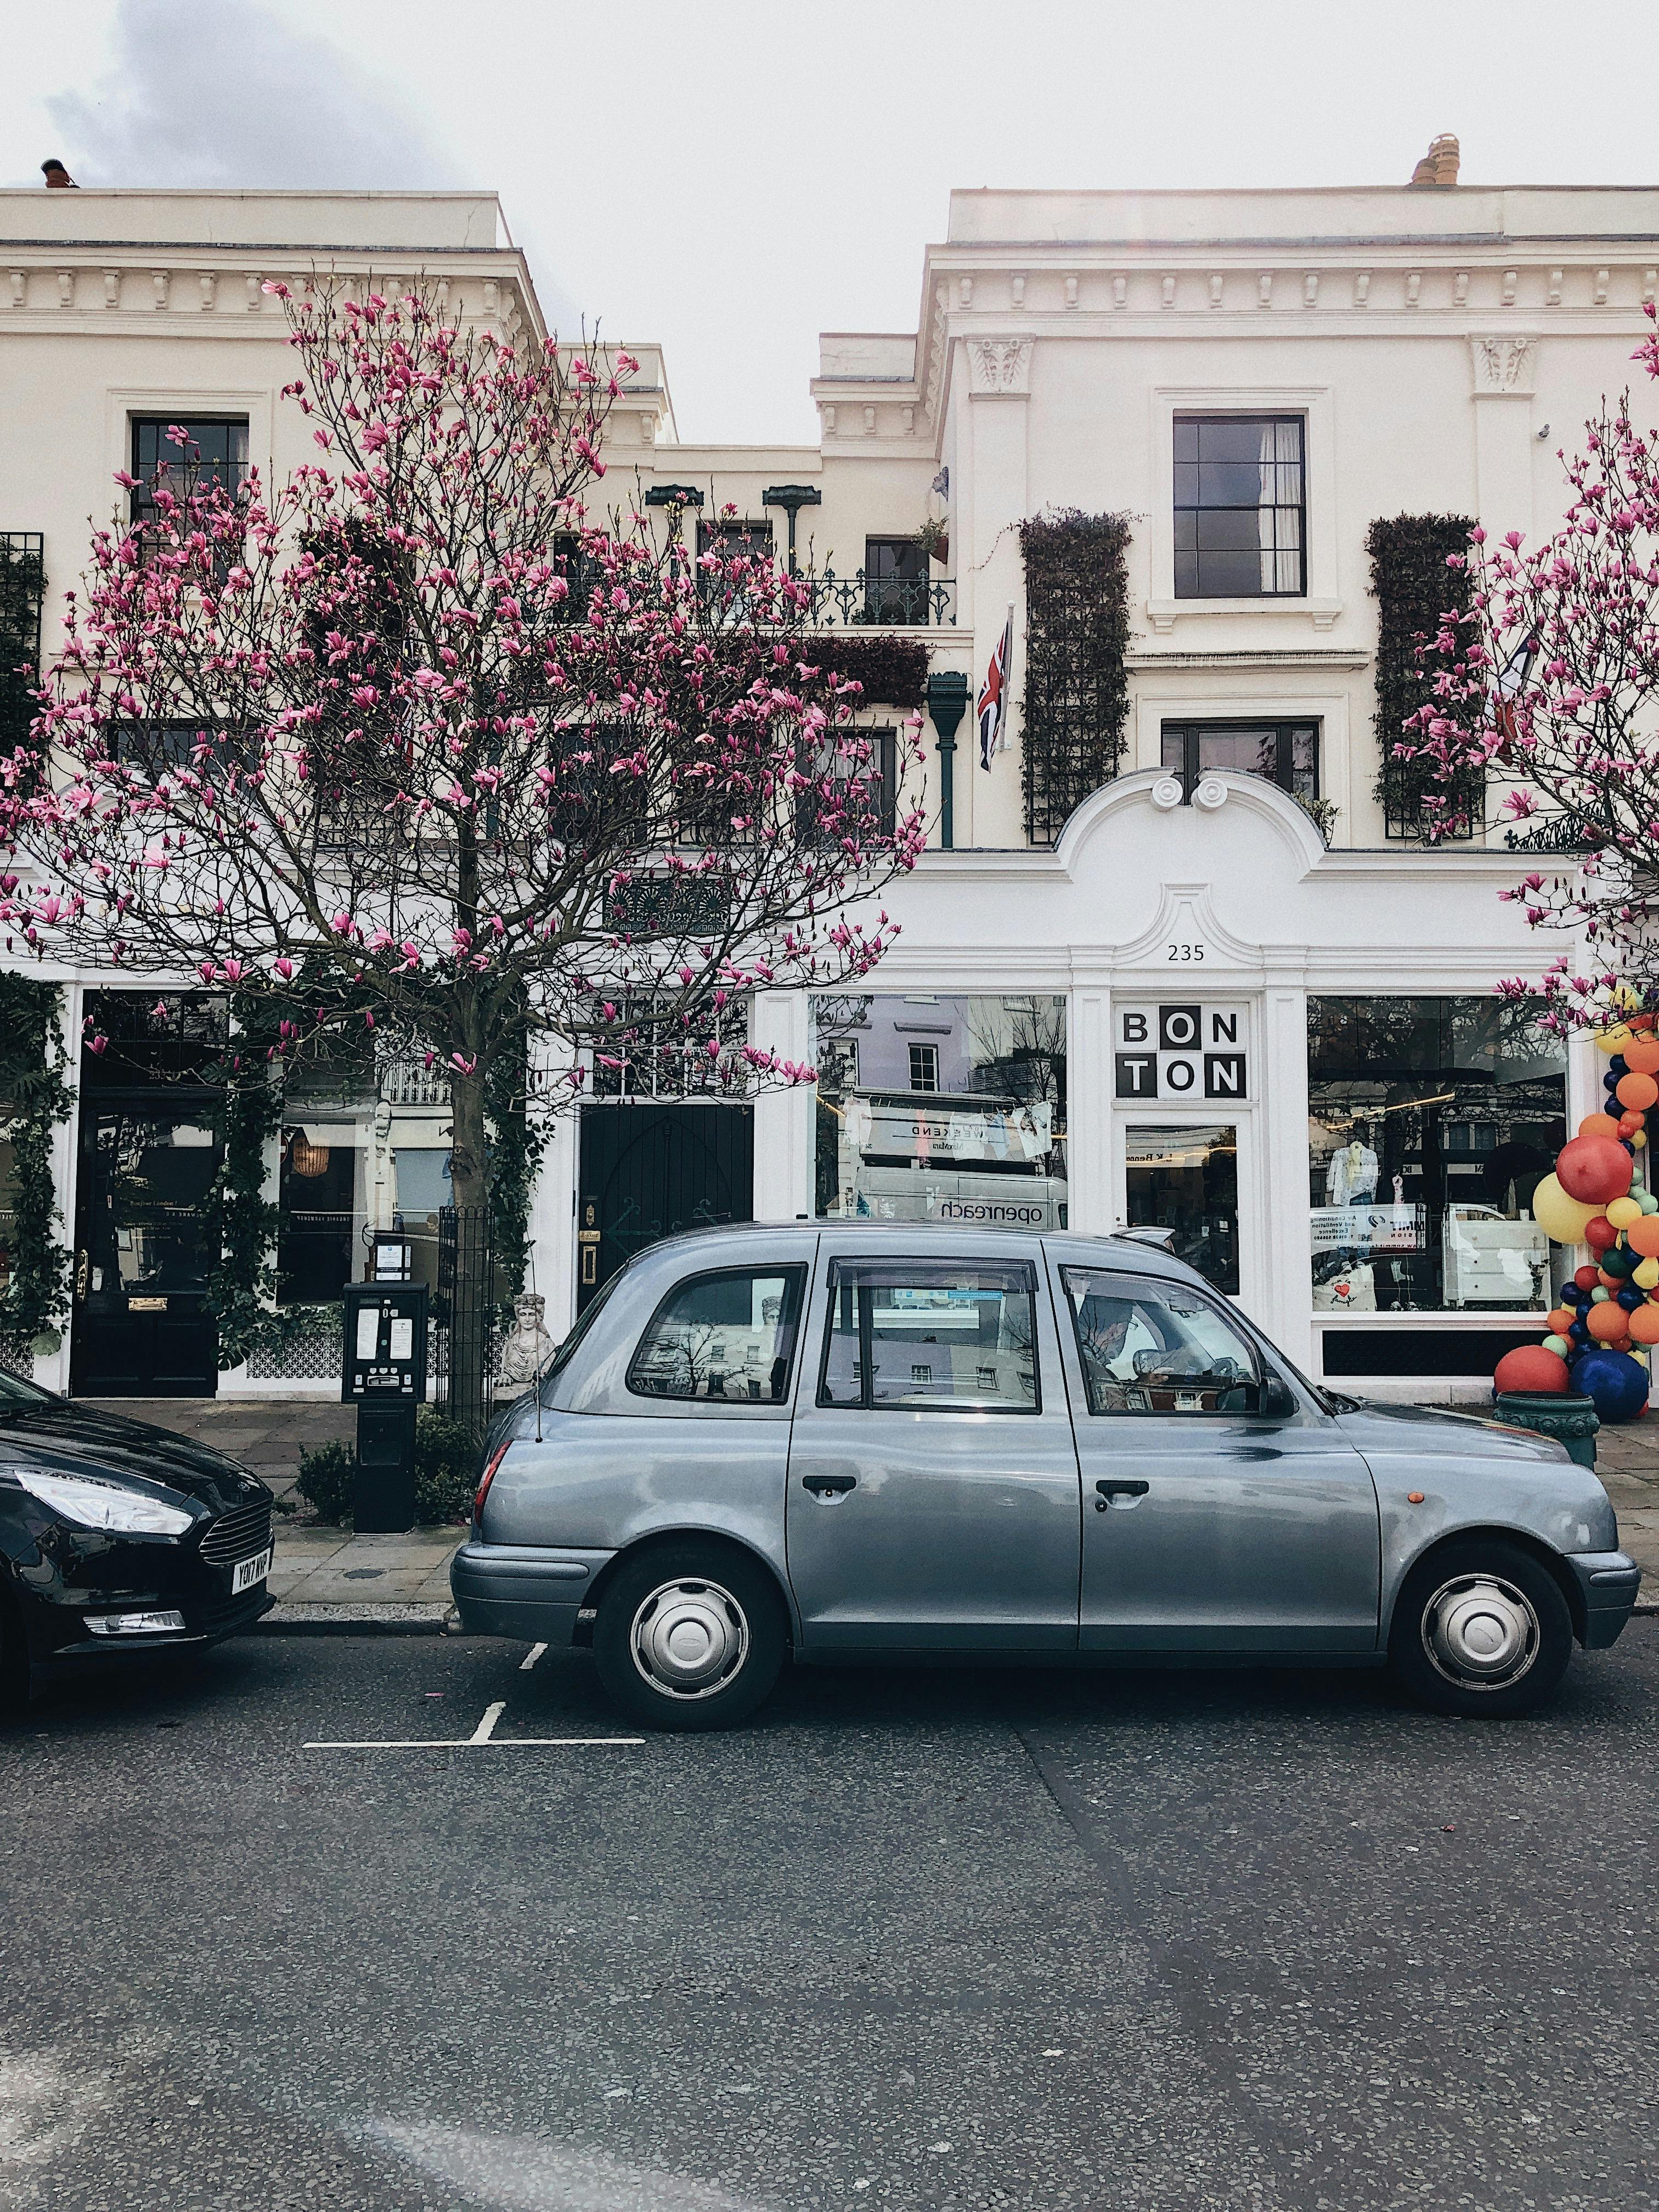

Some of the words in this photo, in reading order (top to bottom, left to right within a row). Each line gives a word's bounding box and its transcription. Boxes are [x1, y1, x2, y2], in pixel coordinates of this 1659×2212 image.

[1168, 945, 1204, 961] 235
[1123, 1012, 1237, 1043] BON
[1124, 1060, 1238, 1091] TON
[239, 1559, 256, 1587] YO17
